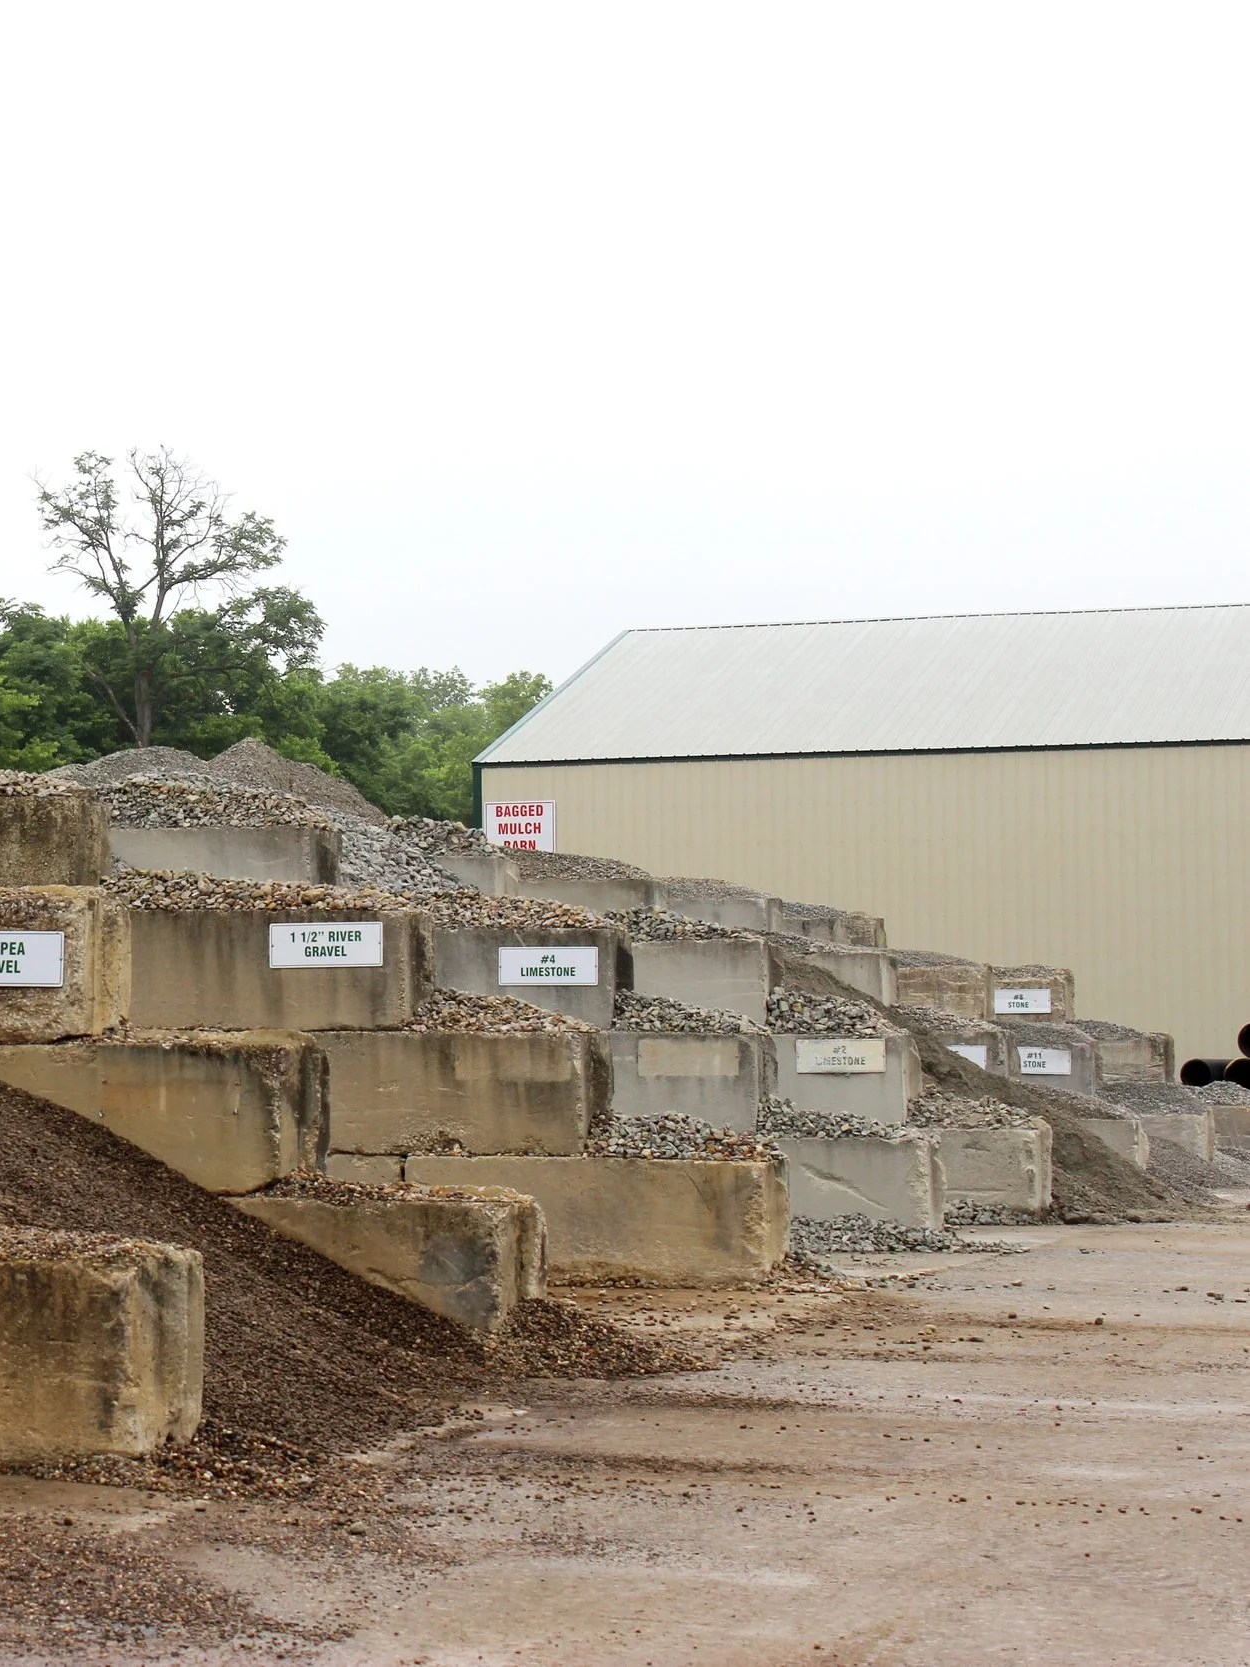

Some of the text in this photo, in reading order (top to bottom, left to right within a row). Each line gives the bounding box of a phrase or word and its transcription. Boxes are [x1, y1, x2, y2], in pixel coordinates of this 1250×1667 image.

[495, 804, 544, 818] BAGGED
[498, 822, 542, 835] MULCH
[290, 932, 296, 943] 1
[328, 930, 362, 943] RIVER
[0, 942, 26, 956] PEA
[304, 945, 348, 957] GRAVEL
[540, 954, 556, 964] #4
[520, 966, 576, 977] LIMESTONE
